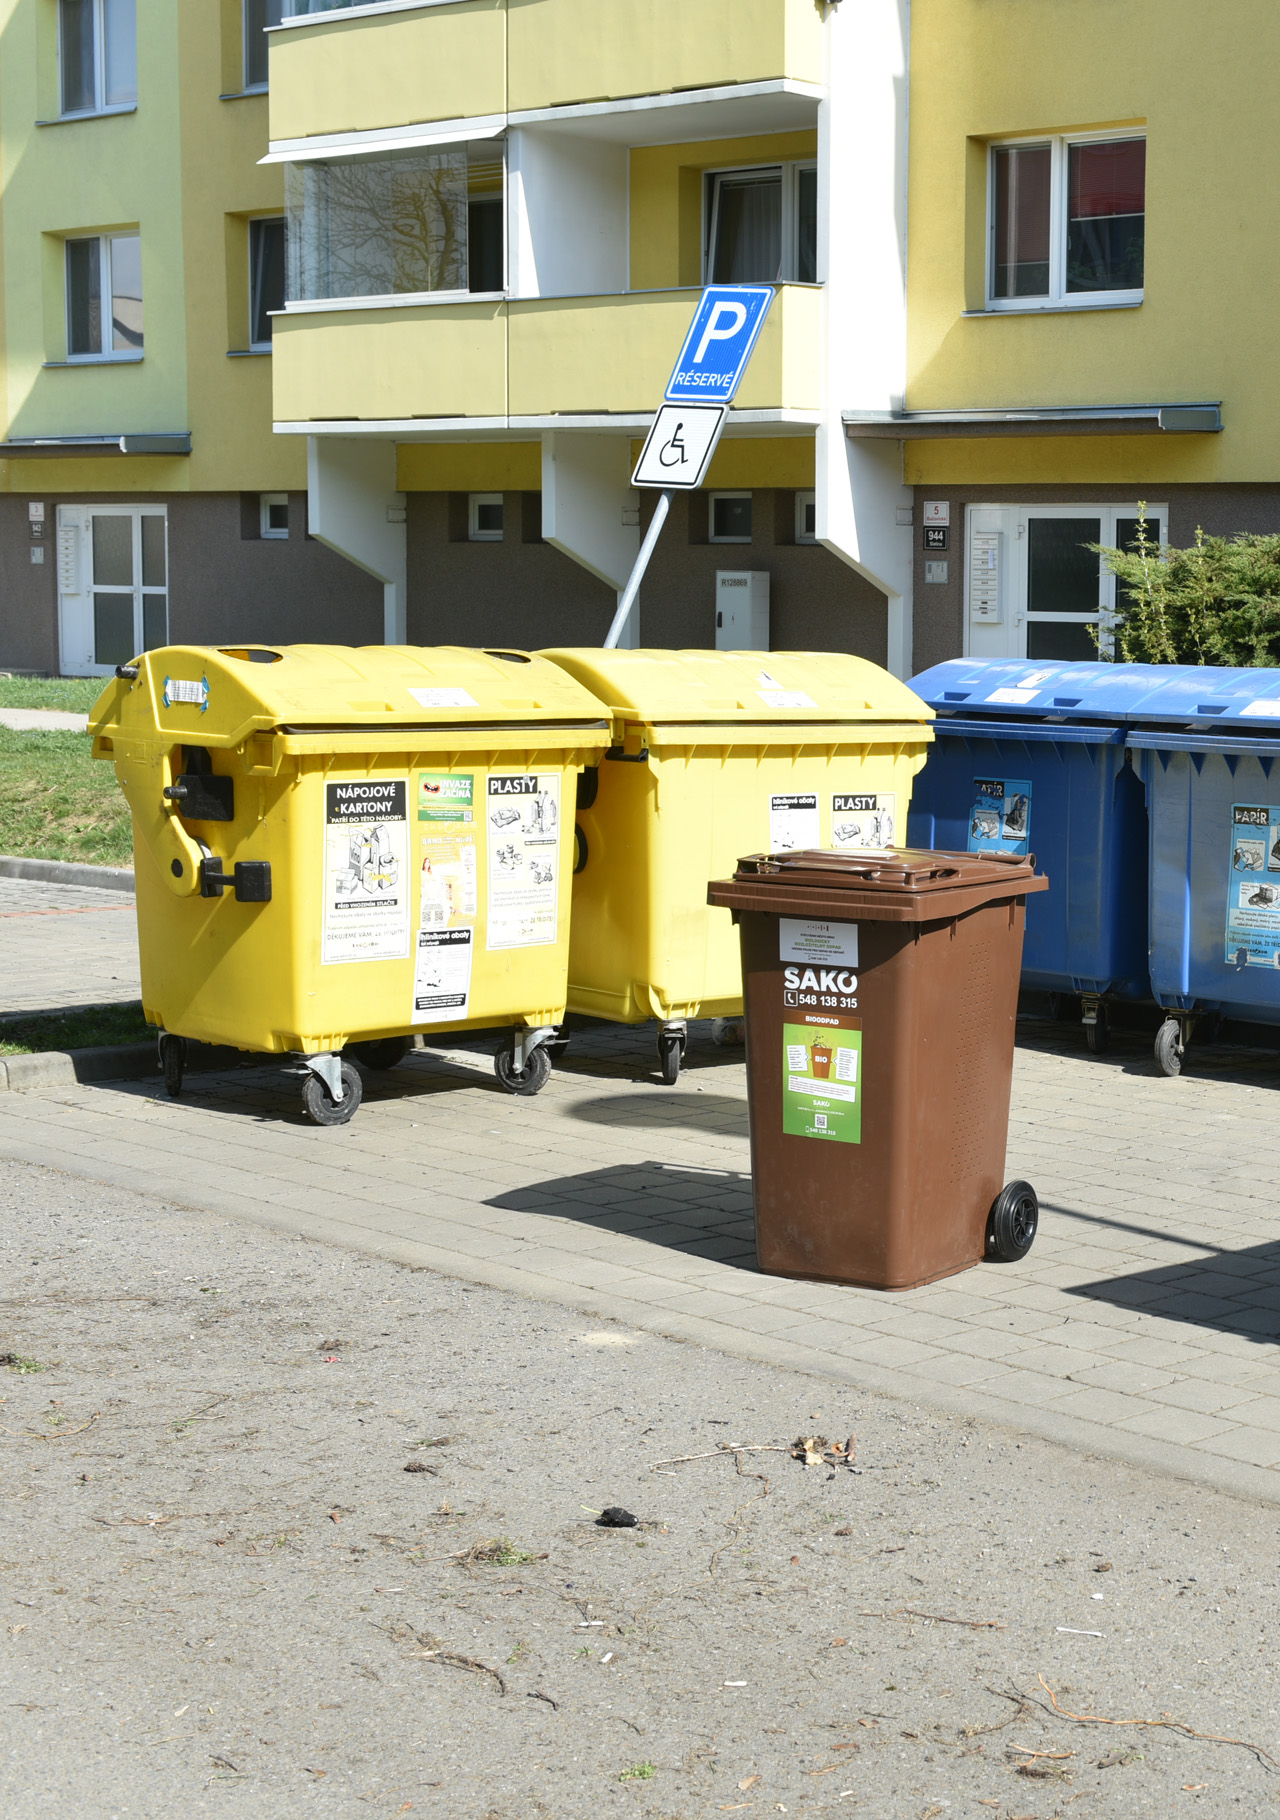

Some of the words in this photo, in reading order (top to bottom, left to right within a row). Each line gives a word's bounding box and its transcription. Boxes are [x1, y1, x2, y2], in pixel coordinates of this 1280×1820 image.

[693, 301, 747, 364] P
[675, 370, 734, 387] RÉSERVÉ
[934, 505, 940, 515] 5
[928, 531, 944, 540] 944
[440, 780, 472, 788] INVAZE
[490, 779, 536, 794] PLASTY
[336, 782, 396, 798] NÁPOJOVÉ
[440, 788, 471, 798] ZAČÍNÁ
[798, 796, 815, 805] obaly
[834, 797, 876, 810] PLASTY
[340, 802, 393, 814] KARTONY
[420, 932, 450, 940] hliníkové
[451, 931, 470, 939] obaly
[784, 966, 858, 994] SAKO
[799, 994, 817, 1005] 548
[820, 995, 837, 1007] 138
[840, 997, 858, 1008] 315
[805, 1015, 840, 1025] BIOODPAD
[814, 1055, 828, 1063] BIO
